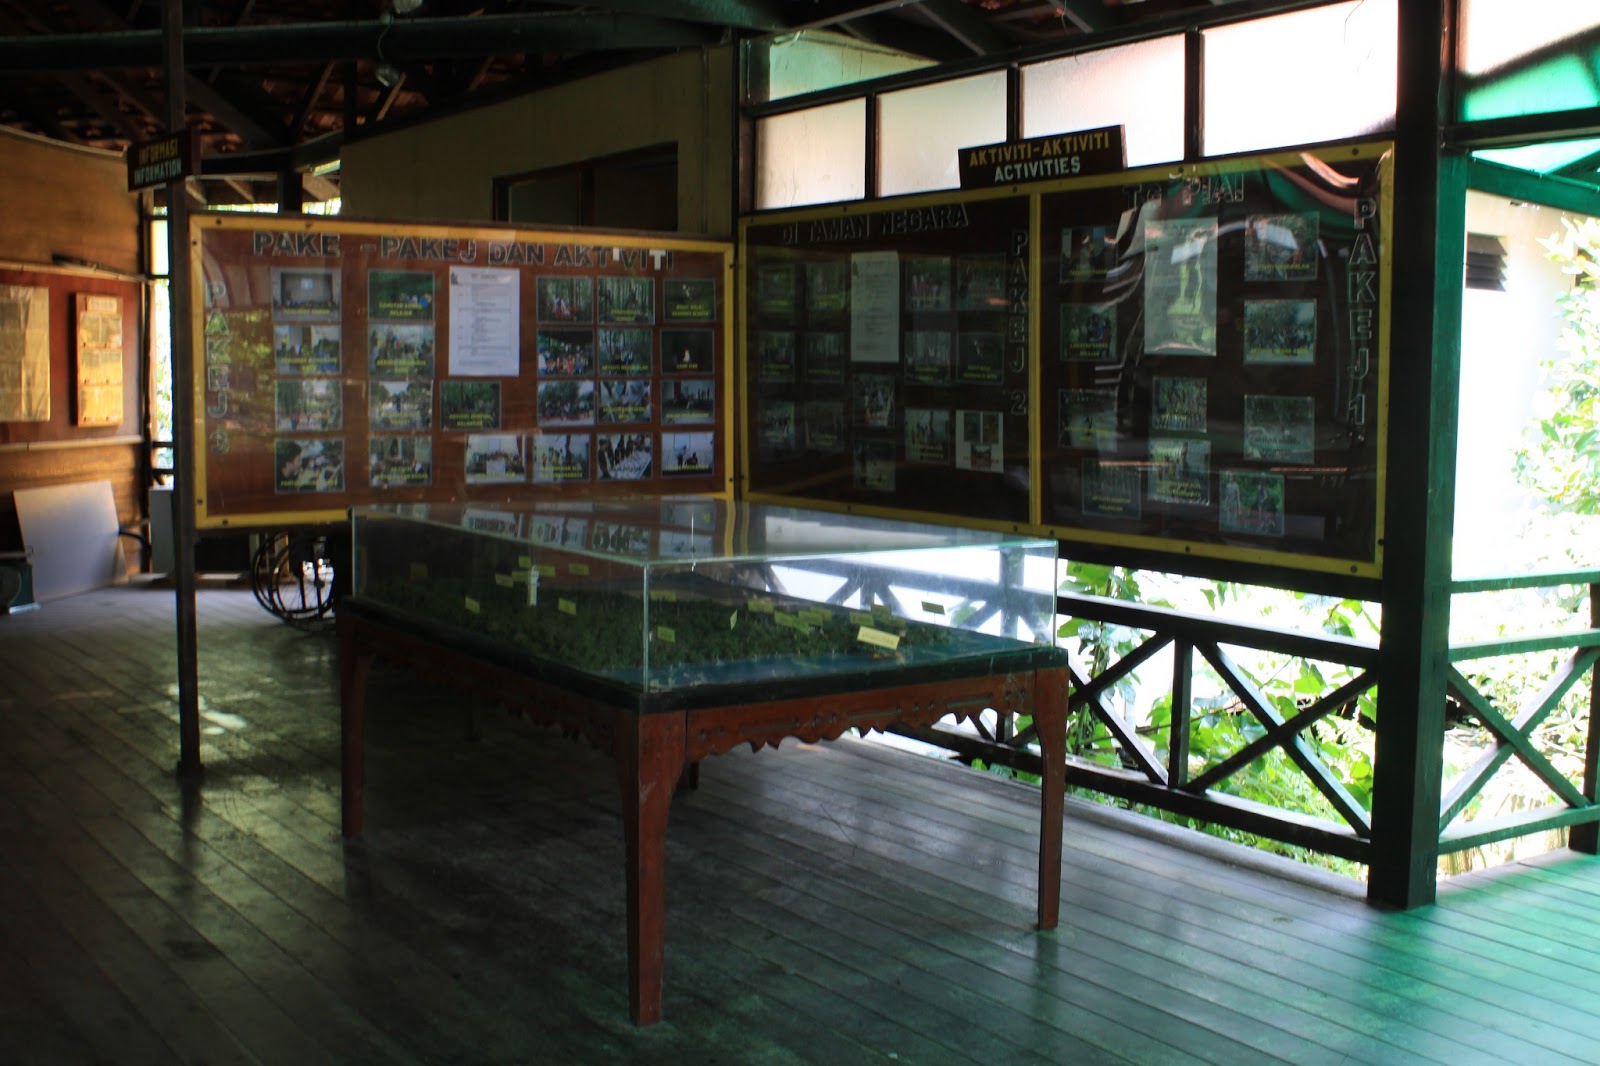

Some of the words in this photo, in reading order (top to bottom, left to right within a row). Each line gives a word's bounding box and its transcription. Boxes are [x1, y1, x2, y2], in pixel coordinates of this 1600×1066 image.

[969, 131, 1110, 168] AKTIVITI-AKTIVITI
[134, 157, 182, 187] INFORMATION
[994, 155, 1081, 183] ACTIVITIES
[253, 231, 340, 257] PAKE
[488, 240, 545, 266] DAN
